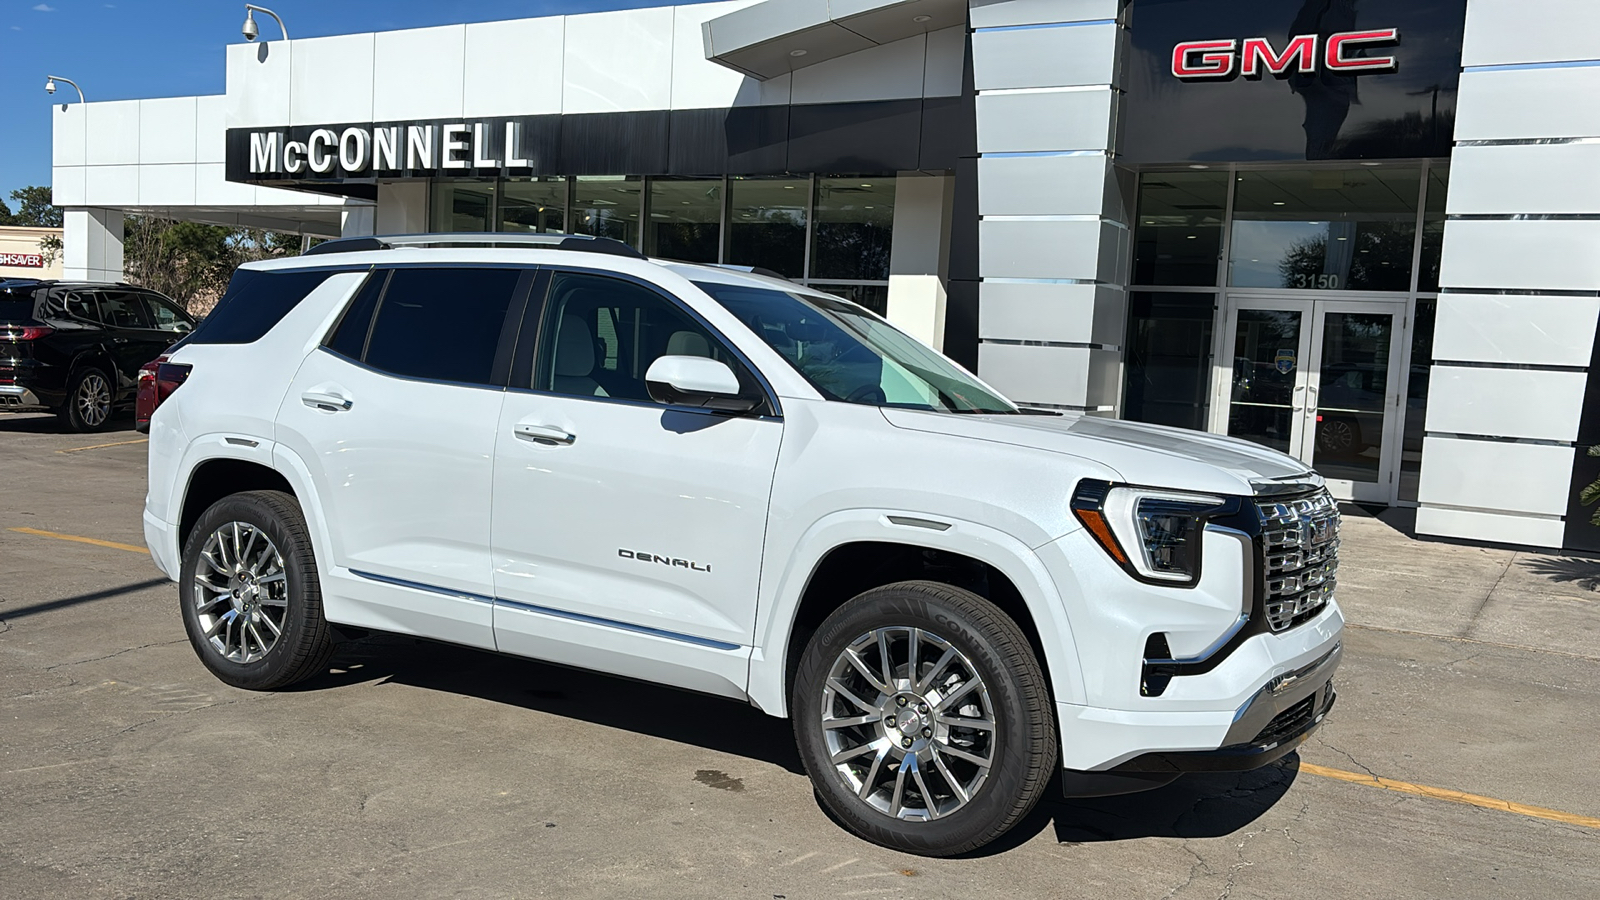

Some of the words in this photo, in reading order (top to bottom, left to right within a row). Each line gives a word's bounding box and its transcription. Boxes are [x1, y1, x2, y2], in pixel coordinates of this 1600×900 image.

[1171, 27, 1398, 79] GMC
[249, 119, 534, 174] McCONNELL
[1296, 273, 1339, 289] 3150
[618, 548, 711, 572] DENALI
